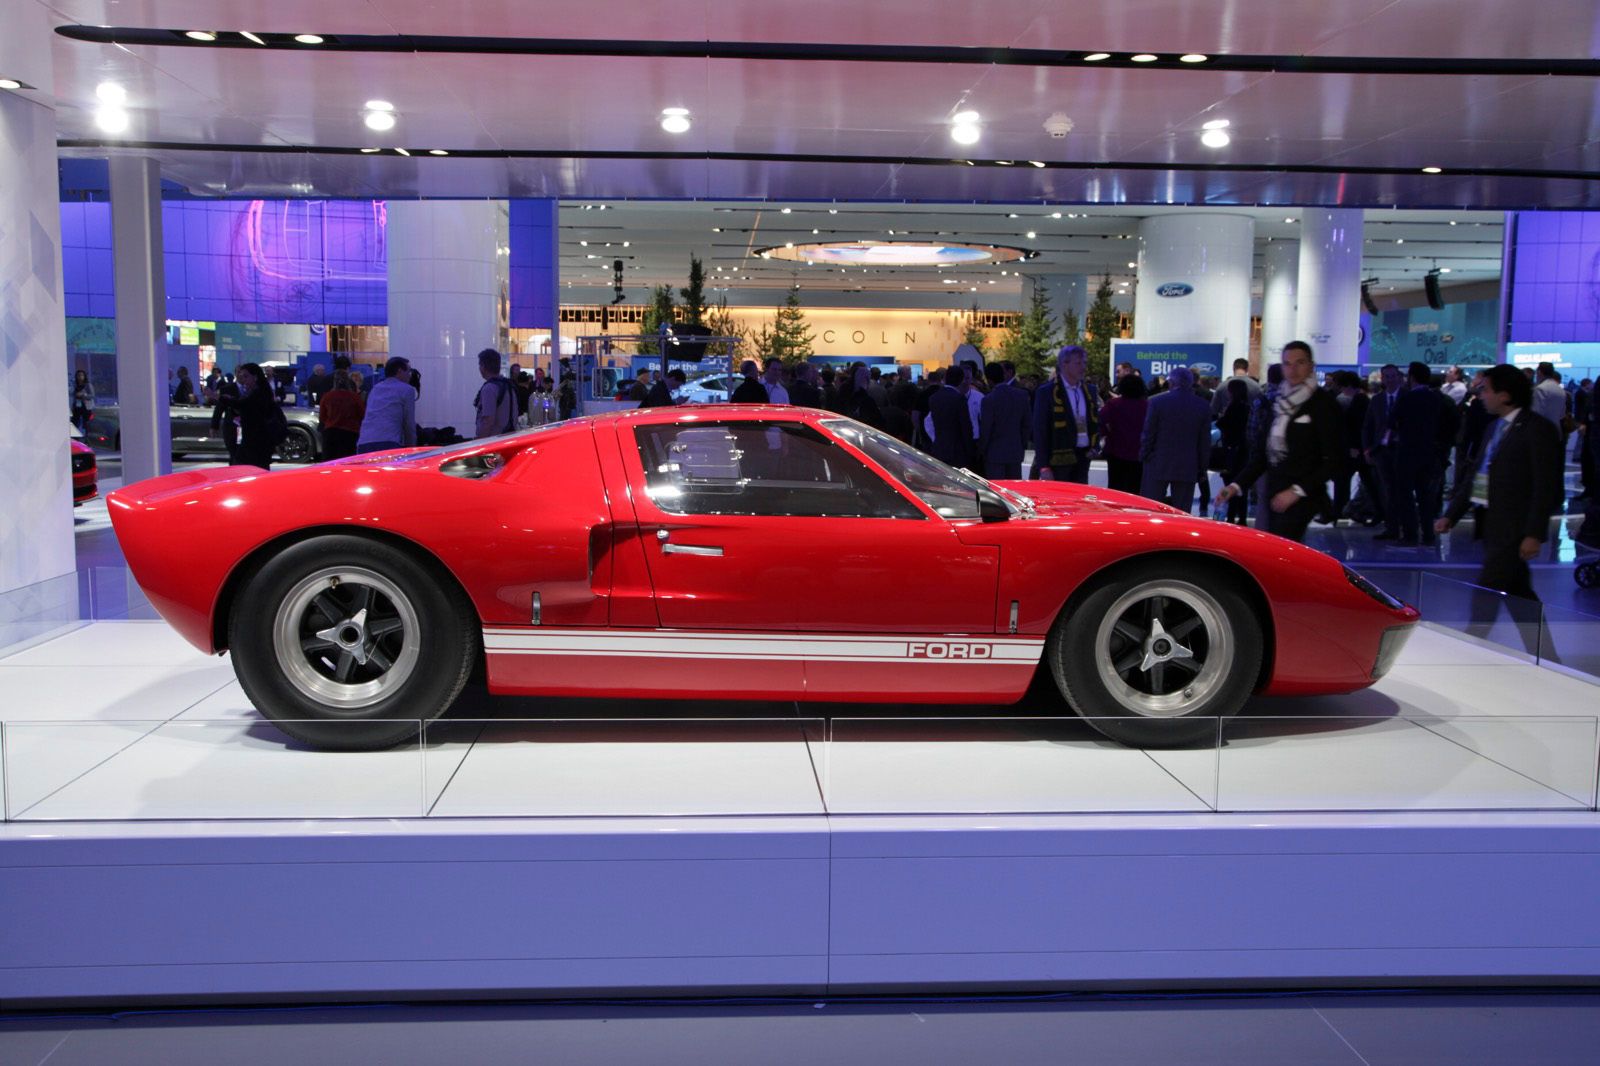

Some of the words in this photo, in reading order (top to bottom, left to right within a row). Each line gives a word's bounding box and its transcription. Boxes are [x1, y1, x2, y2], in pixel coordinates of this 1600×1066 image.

[823, 329, 916, 344] COLN
[1136, 351, 1170, 360] Behind
[1172, 351, 1188, 360] the
[648, 363, 680, 371] Bend
[682, 363, 698, 371] the
[908, 642, 991, 658] FORD
